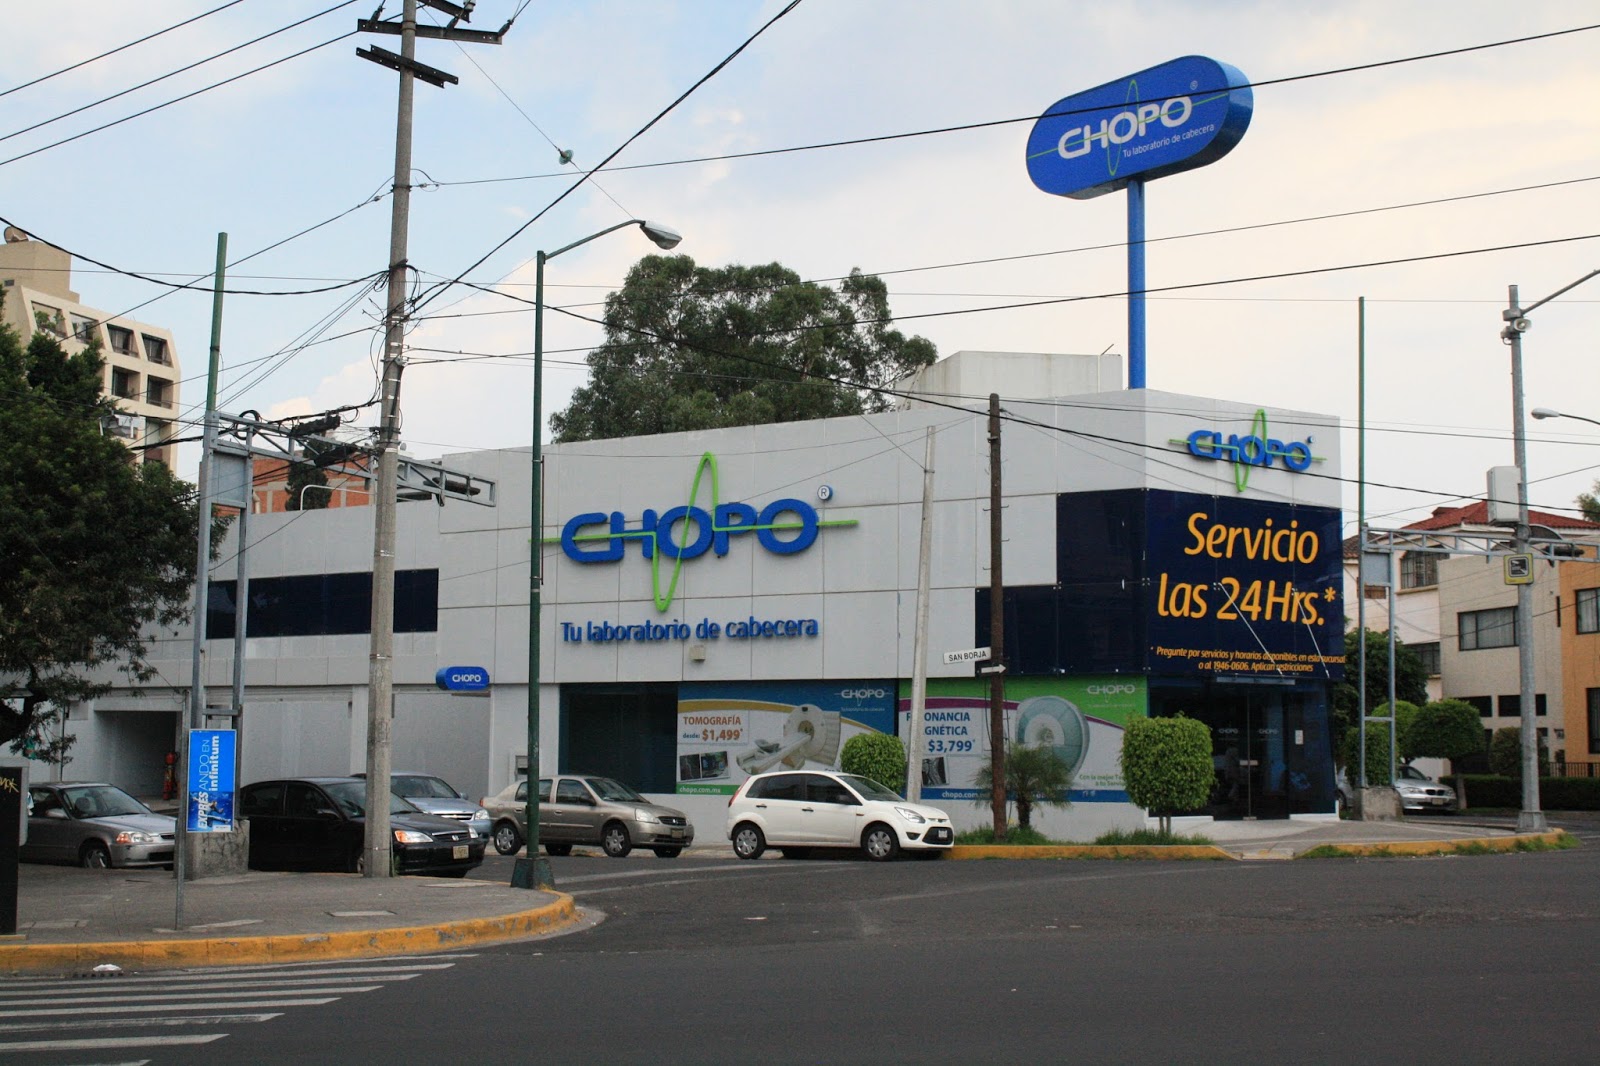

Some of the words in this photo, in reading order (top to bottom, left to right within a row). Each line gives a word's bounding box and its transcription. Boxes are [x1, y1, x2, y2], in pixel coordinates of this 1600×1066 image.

[1058, 95, 1192, 159] CHOPO
[1123, 149, 1131, 158] Tu
[1132, 137, 1170, 155] laboratorio
[1171, 134, 1181, 144] de
[1182, 123, 1215, 140] cabecera
[1187, 430, 1312, 471] CHOPO
[561, 498, 819, 563] CHOPO
[1184, 512, 1319, 564] Servicio
[1158, 572, 1208, 618] las
[561, 622, 582, 642] Tu
[587, 618, 691, 642] laboratorio
[696, 618, 720, 640] de
[726, 616, 818, 638] cabecera
[948, 653, 963, 662] SAN
[963, 650, 987, 660] BORJA
[1157, 646, 1188, 659] Pregunte
[1188, 650, 1200, 659] por
[1201, 649, 1229, 659] servicios
[1235, 651, 1262, 660] horarios
[1251, 662, 1275, 673] Aplican
[452, 674, 482, 683] CHOPO
[841, 688, 885, 699] CHOPO
[1087, 684, 1136, 695] CHOPO
[683, 714, 742, 726] TOMOGRAFÍA
[202, 739, 211, 753] EN
[208, 735, 220, 792] infinitum
